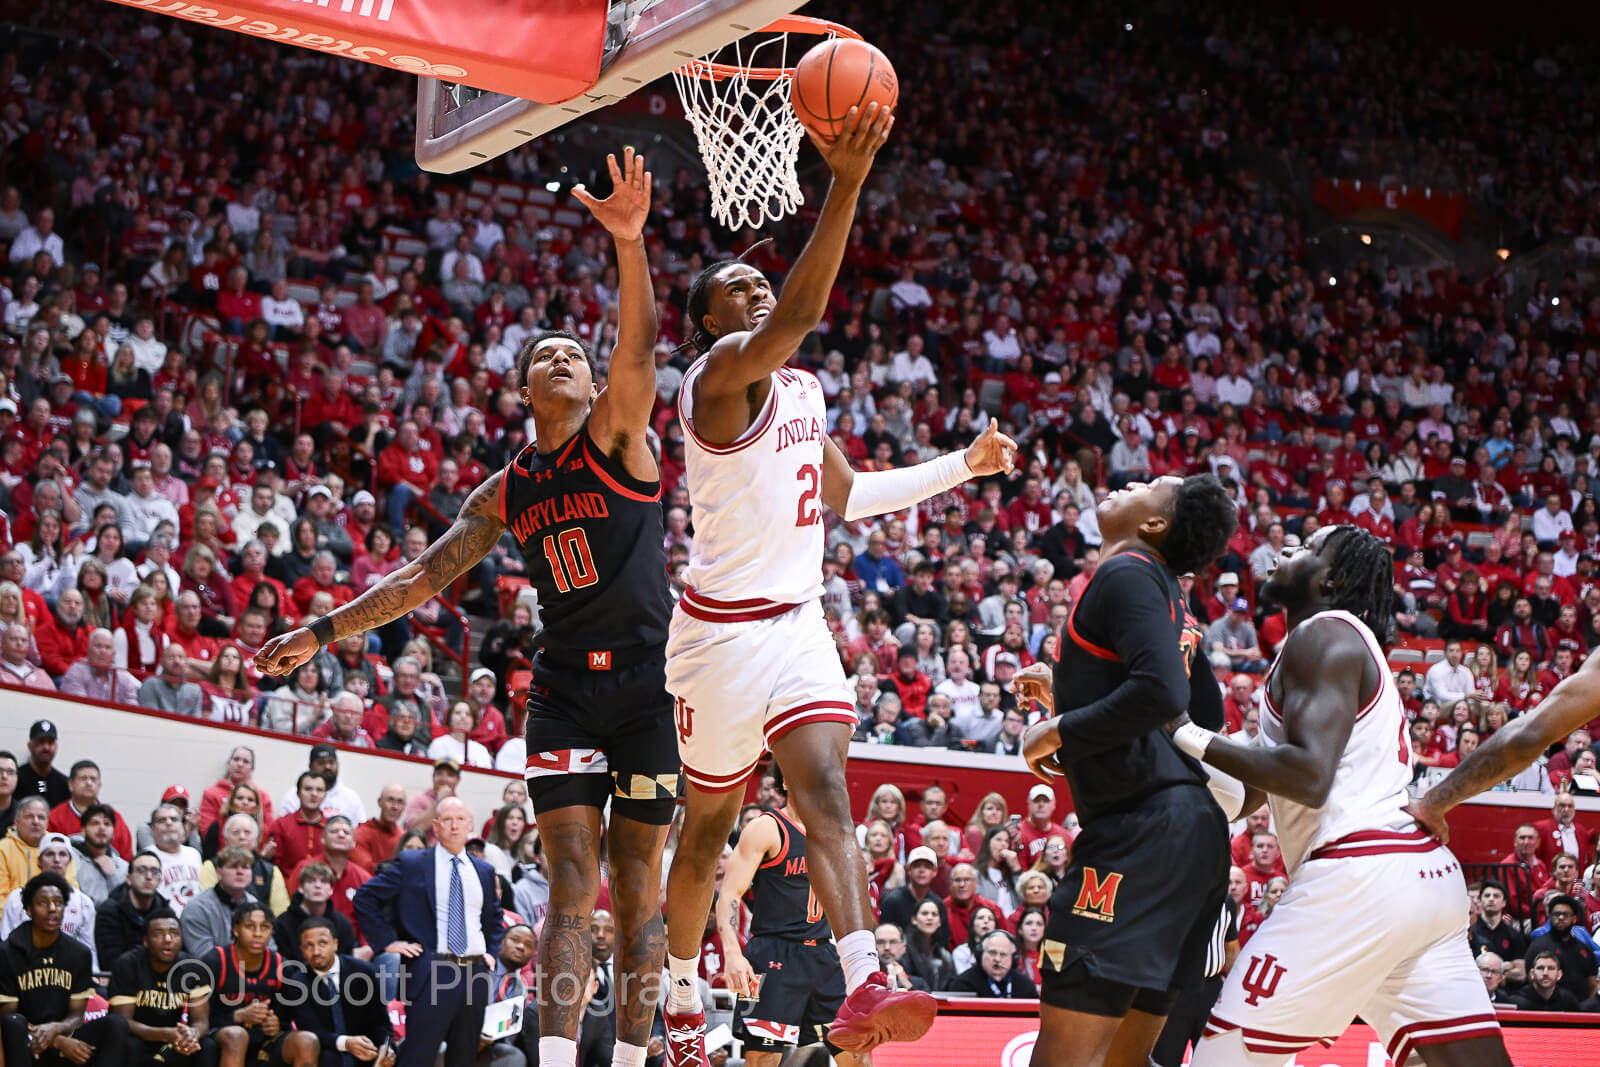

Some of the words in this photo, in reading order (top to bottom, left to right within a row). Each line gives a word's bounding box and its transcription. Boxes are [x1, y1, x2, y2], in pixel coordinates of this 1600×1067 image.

[240, 21, 387, 60] State
[510, 492, 610, 549] MARYLAND
[543, 527, 599, 593] 10
[592, 652, 607, 666] M
[1074, 867, 1124, 917] M
[17, 967, 73, 991] MARYLAND
